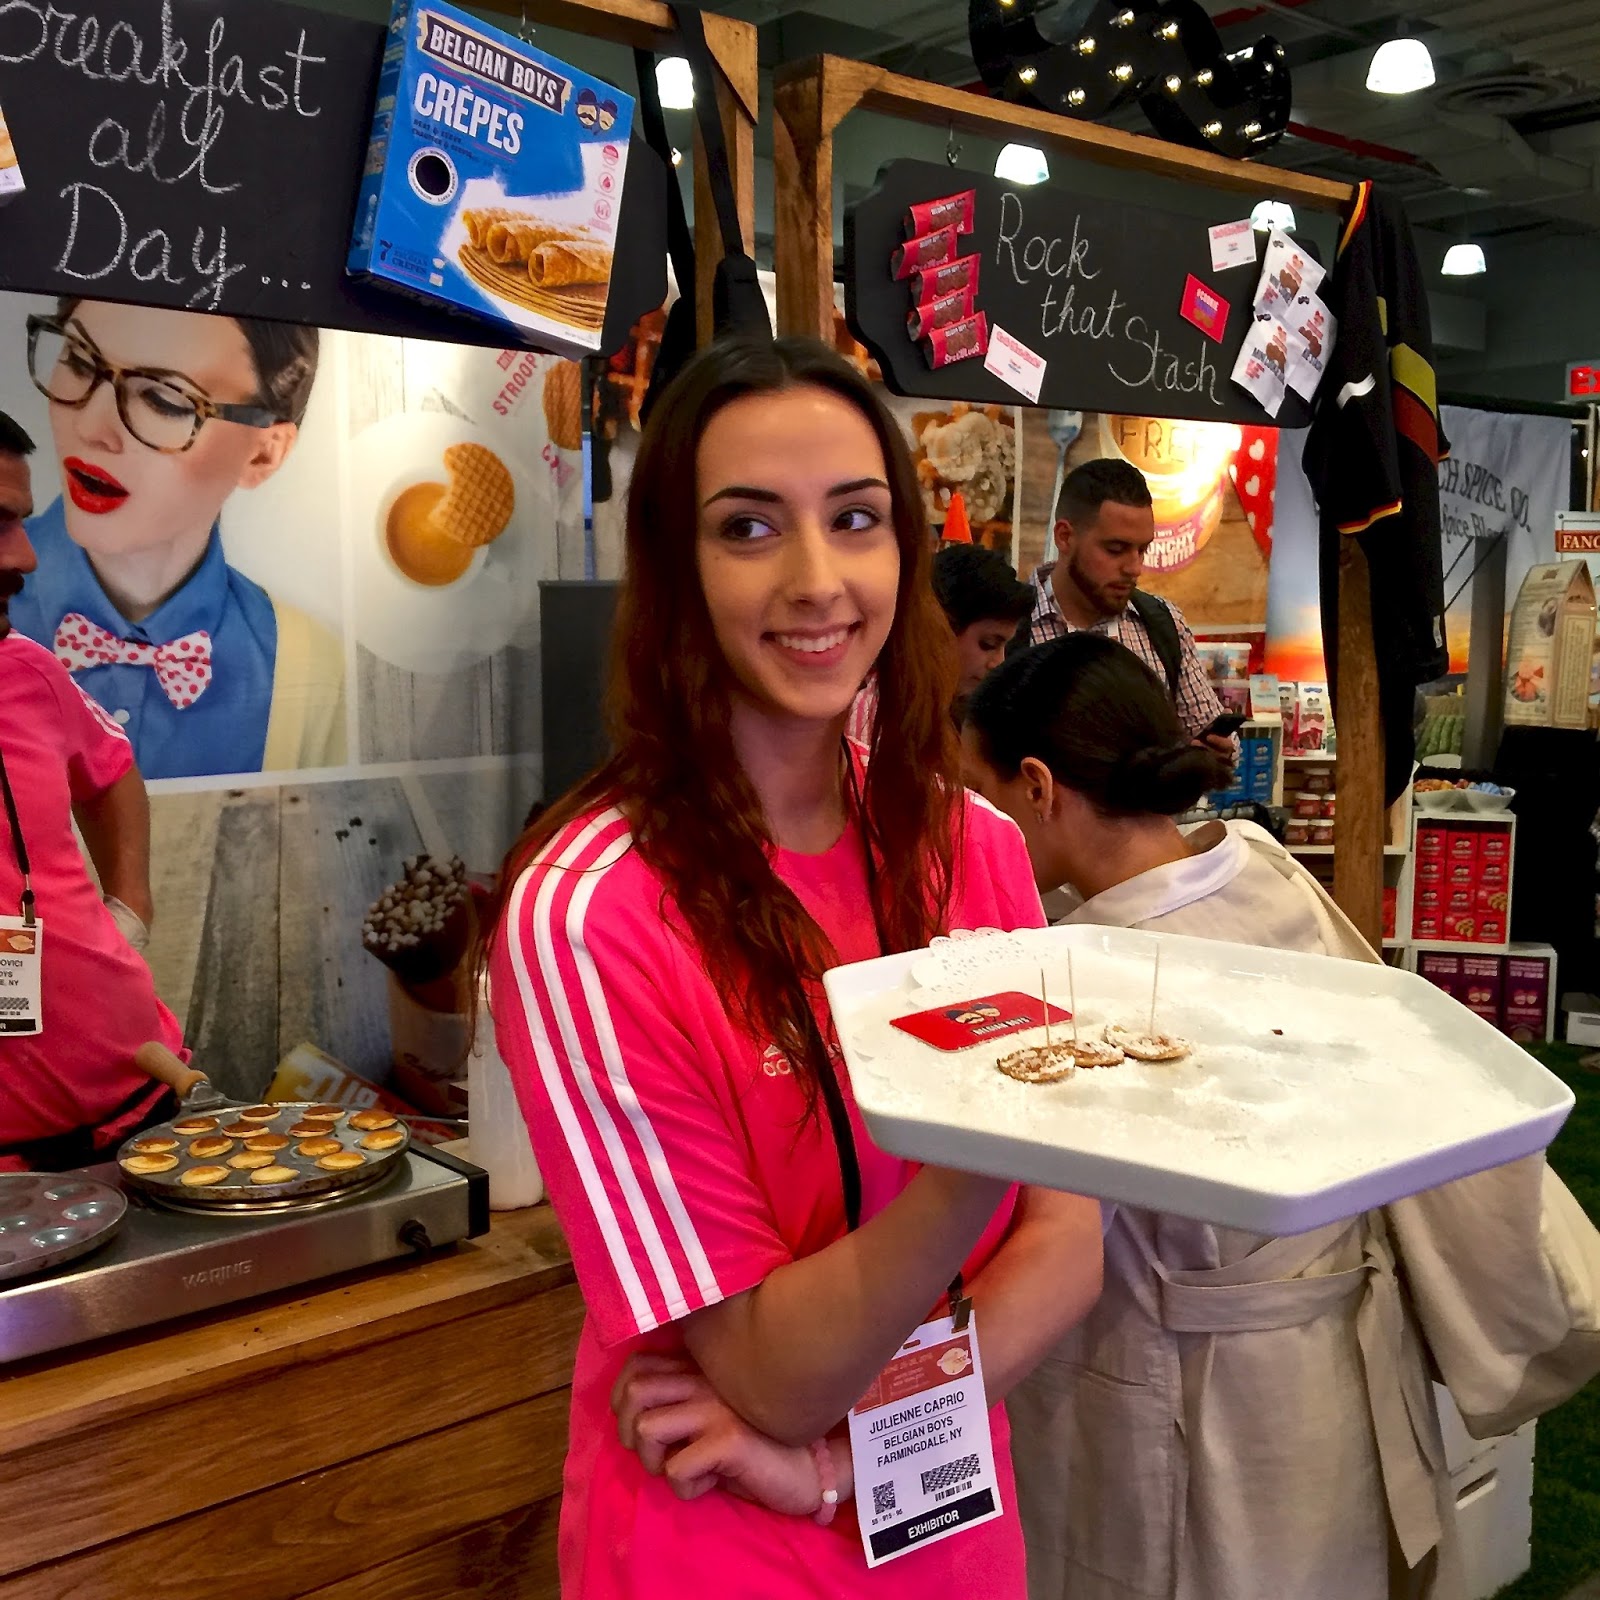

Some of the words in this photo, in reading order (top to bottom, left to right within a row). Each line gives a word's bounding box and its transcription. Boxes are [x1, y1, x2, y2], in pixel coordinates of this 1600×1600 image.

[429, 23, 509, 83] BELGIAN
[511, 60, 558, 106] BOYS
[414, 72, 524, 155] CRÊPES
[996, 192, 1101, 285] Rock
[1041, 284, 1127, 339] that
[1107, 315, 1226, 406] Stash
[1459, 461, 1507, 512] SPICE
[869, 1405, 922, 1435] JULIENNE
[923, 1390, 965, 1414] CAPRIO
[883, 1425, 925, 1450] BELGIAN
[927, 1415, 954, 1433] BOYS
[877, 1432, 949, 1468] FARMINGDALE,
[950, 1426, 963, 1441] NY
[907, 1509, 961, 1539] EXHIBITOR
